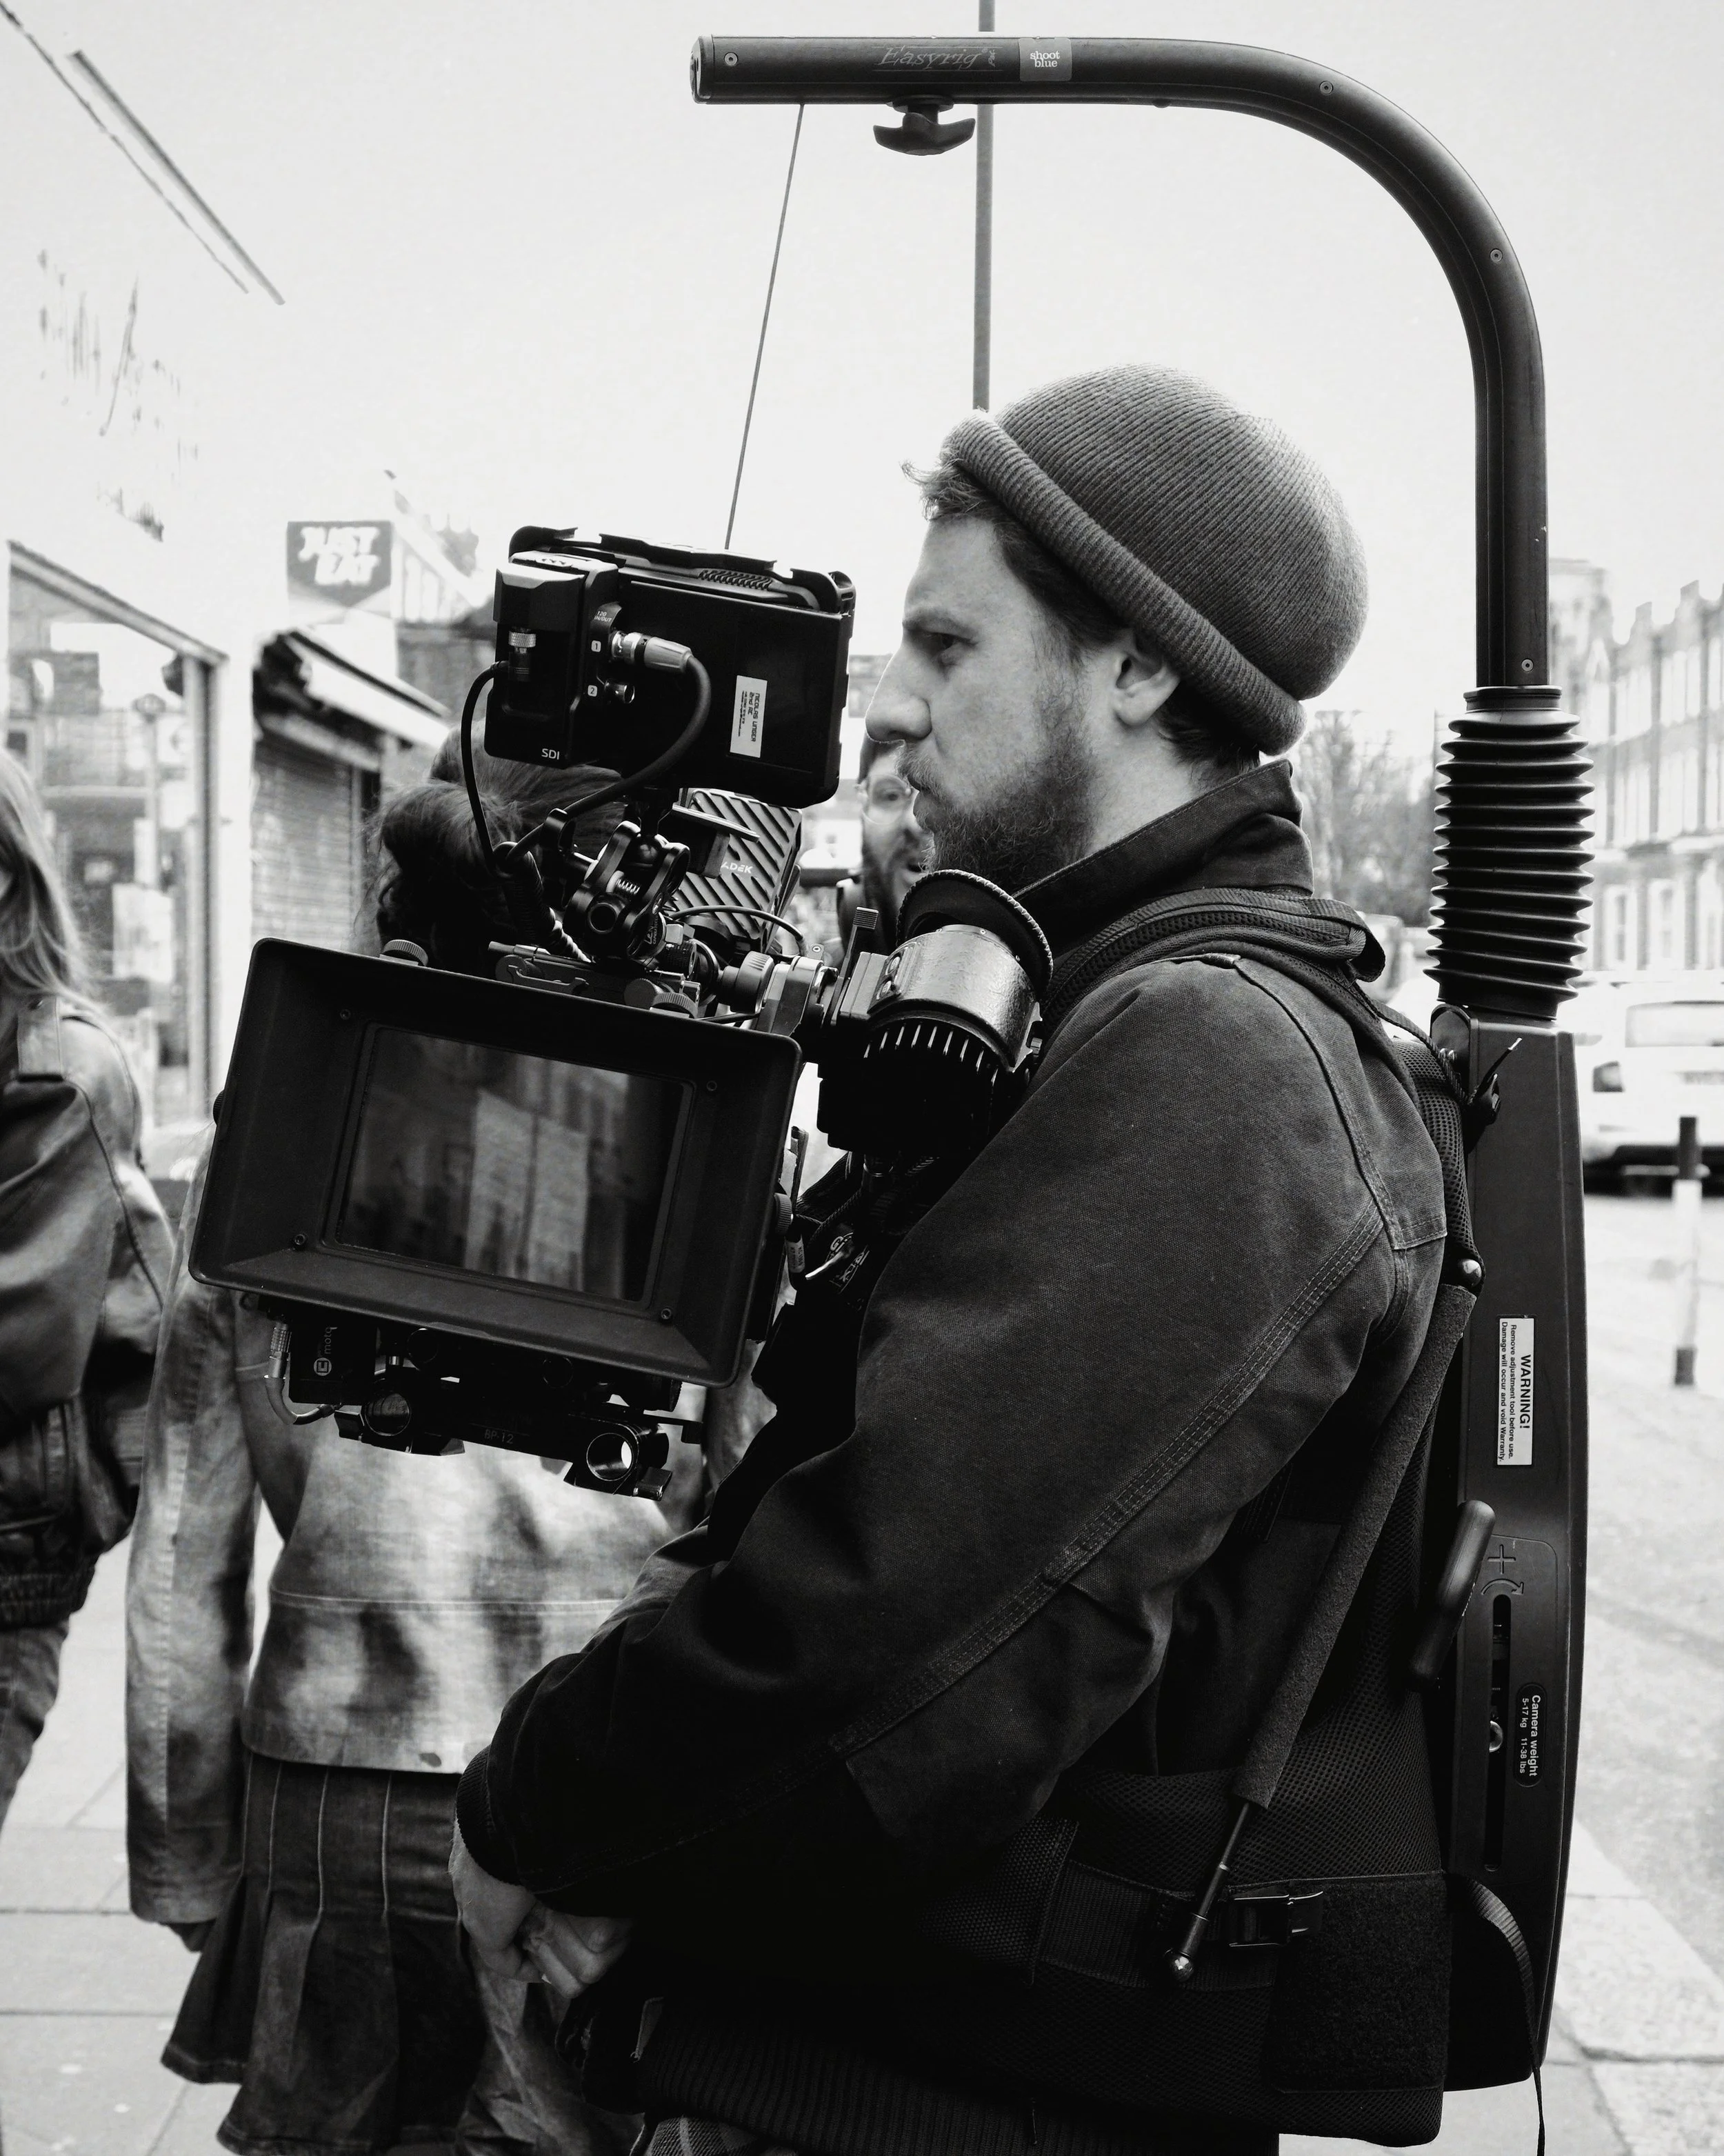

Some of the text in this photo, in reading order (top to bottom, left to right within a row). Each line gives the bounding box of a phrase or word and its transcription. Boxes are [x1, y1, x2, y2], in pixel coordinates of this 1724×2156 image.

[1030, 50, 1060, 60] shoot
[1034, 58, 1058, 68] blue
[594, 615, 612, 623] IN/OUT
[752, 692, 761, 719] NICOLAS
[541, 748, 560, 760] SDI
[1500, 1321, 1508, 1353] Damage
[1519, 1354, 1532, 1429] WARNING!
[1498, 1426, 1507, 1462] Warranty.
[1520, 1717, 1529, 1728] kg
[1527, 1695, 1541, 1777] Camera weight
[1520, 1737, 1528, 1759] 11-38
